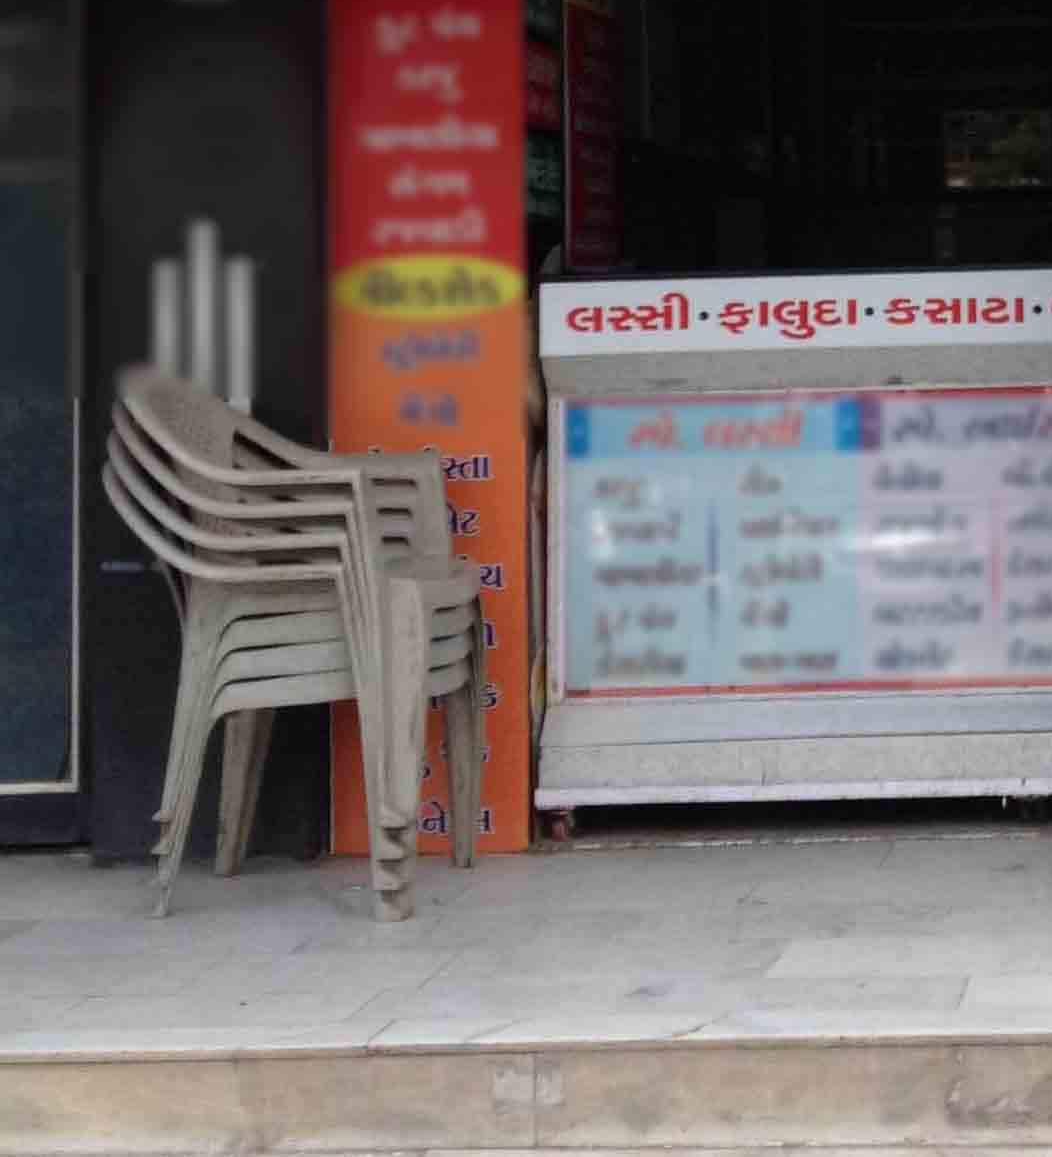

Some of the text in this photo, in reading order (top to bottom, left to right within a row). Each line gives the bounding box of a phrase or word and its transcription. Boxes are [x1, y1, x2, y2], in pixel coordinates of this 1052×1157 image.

[566, 292, 689, 332] લસ્સી
[719, 299, 858, 340] ફાલુદા
[884, 297, 1025, 324] કસાટા
